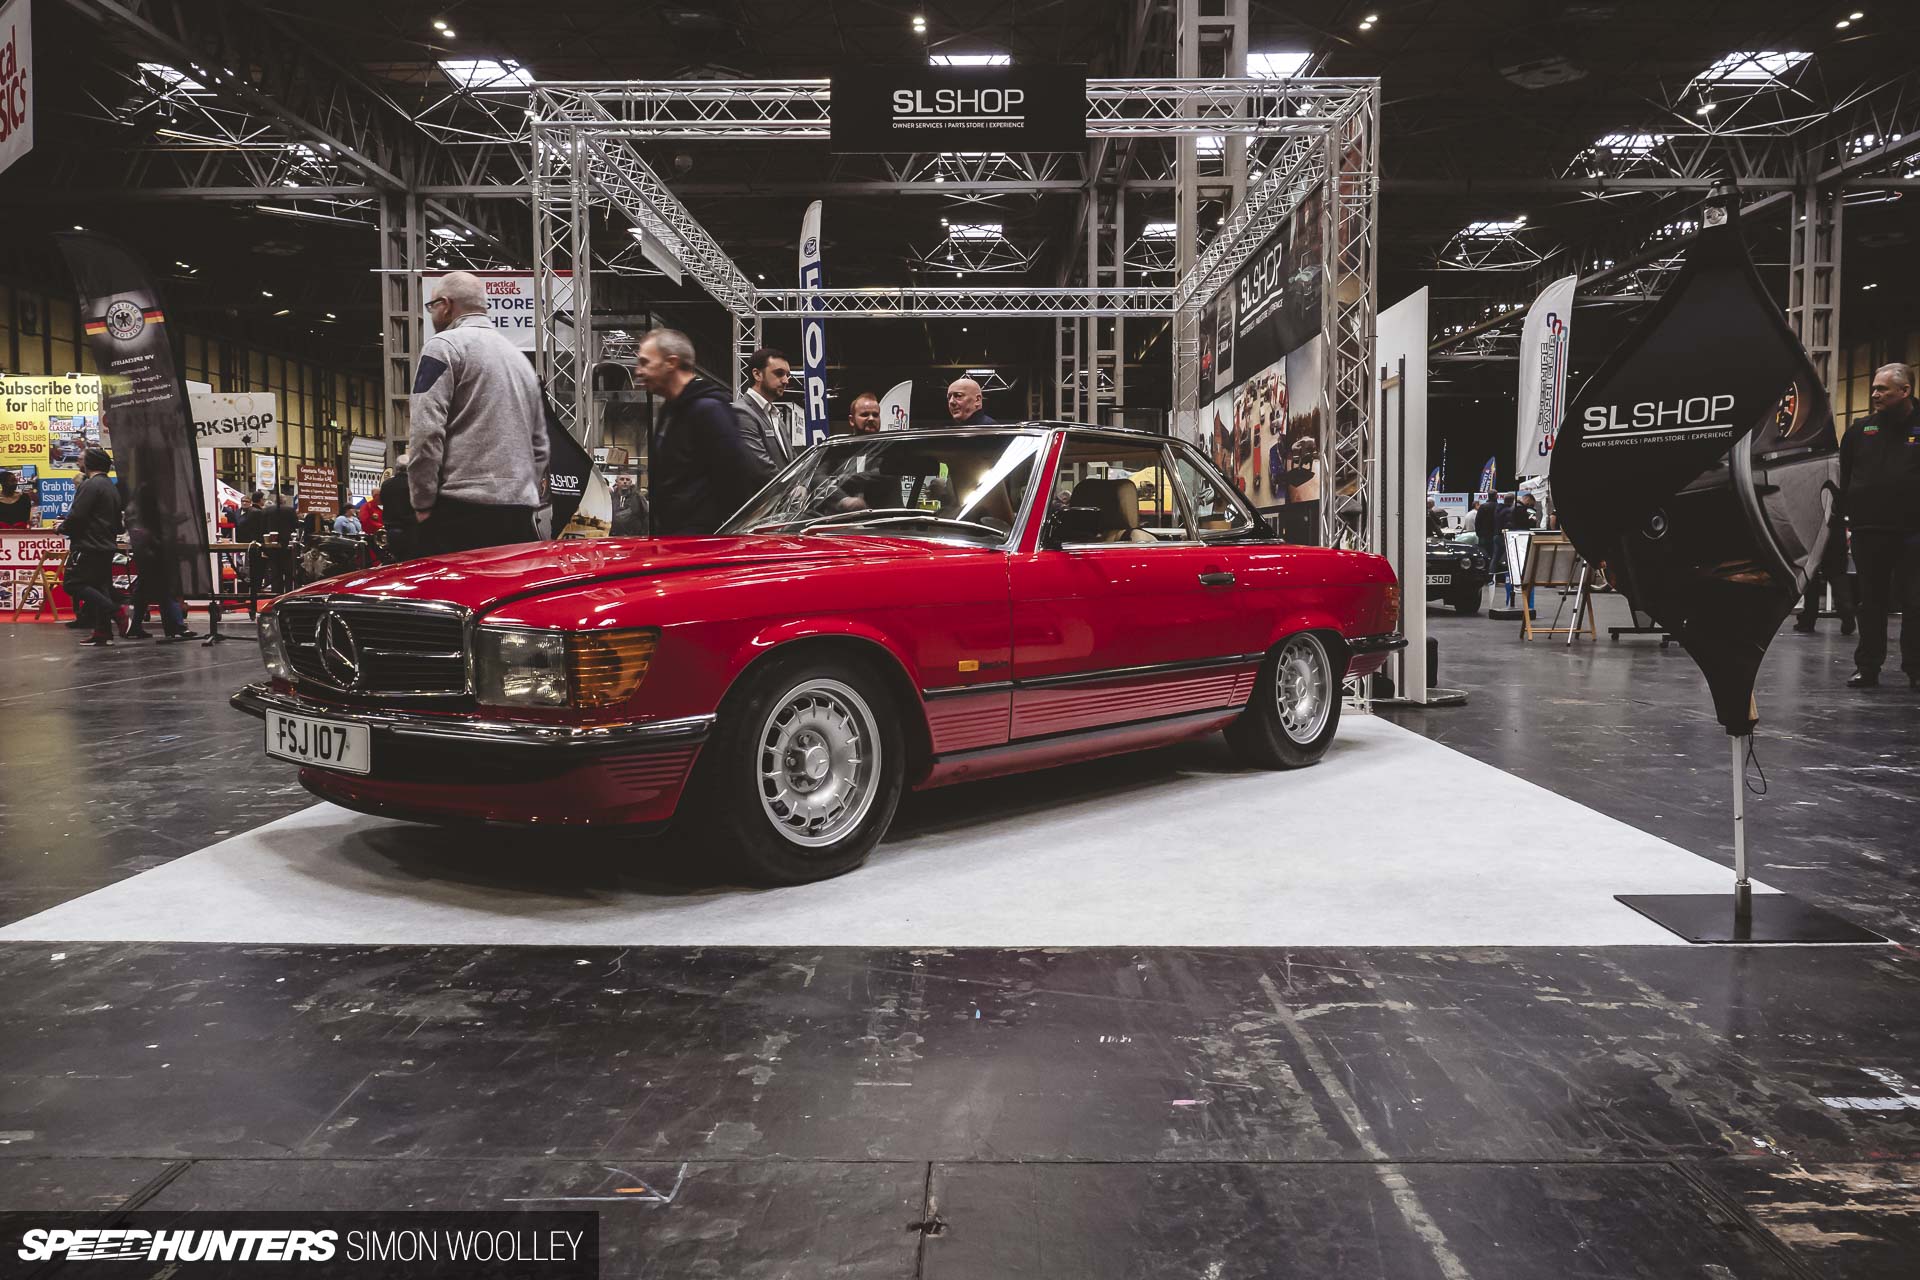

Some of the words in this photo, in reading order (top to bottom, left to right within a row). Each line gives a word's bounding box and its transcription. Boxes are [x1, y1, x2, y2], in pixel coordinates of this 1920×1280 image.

[487, 298, 546, 310] STORE
[514, 316, 536, 328] YE
[0, 380, 72, 396] Subscribe
[1543, 379, 1553, 433] CAPRI
[1548, 335, 1556, 379] CLUB
[6, 398, 28, 412] for
[31, 399, 52, 412] half
[55, 398, 74, 412] the
[1583, 394, 1735, 432] SLSHOP
[16, 421, 38, 431] 50%
[39, 422, 46, 431] &
[12, 432, 21, 442] 13
[22, 433, 47, 442] issues
[1581, 440, 1606, 448] OWNER
[1607, 438, 1638, 446] SERVICES
[1665, 434, 1686, 442] STORE
[1691, 430, 1733, 440] EXPERIENCE
[42, 481, 61, 492] Grab
[62, 481, 75, 491] the
[42, 492, 64, 502] issue
[42, 503, 60, 514] only
[18, 538, 65, 550] practical
